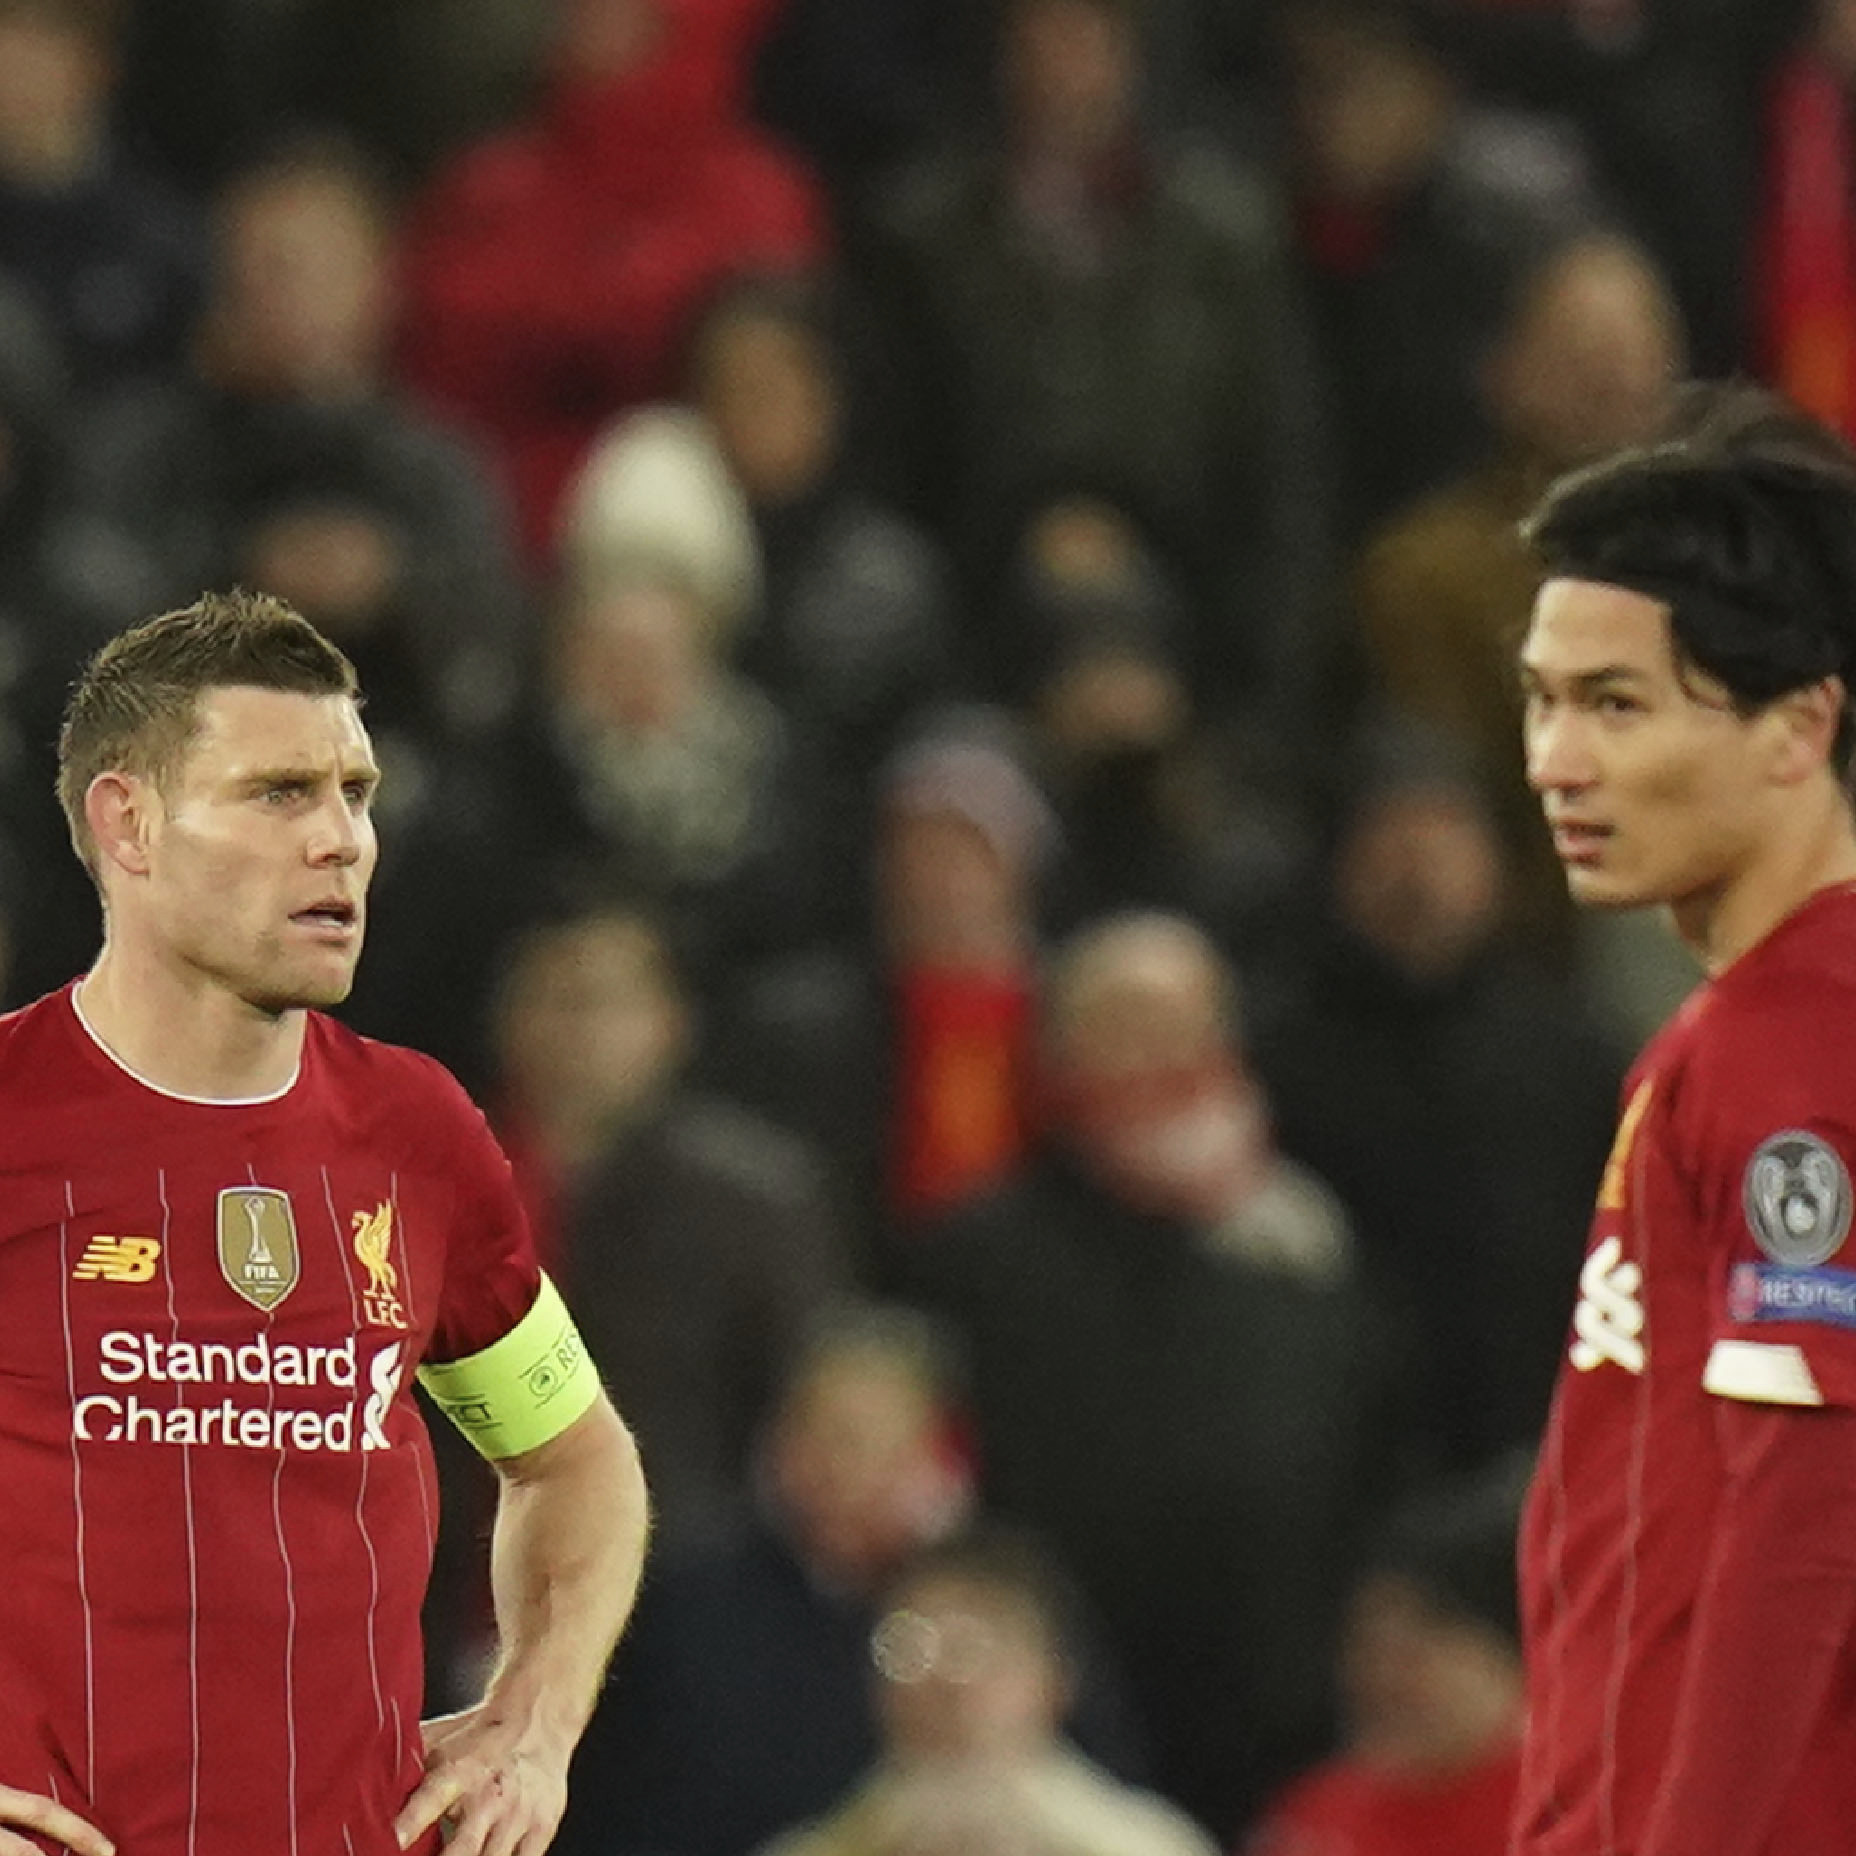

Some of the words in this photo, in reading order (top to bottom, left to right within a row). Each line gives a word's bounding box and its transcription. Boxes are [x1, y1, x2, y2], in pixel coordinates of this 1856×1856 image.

[244, 1263, 280, 1279] FIFA
[99, 1330, 357, 1387] Standard
[74, 1395, 354, 1453] Chartered
